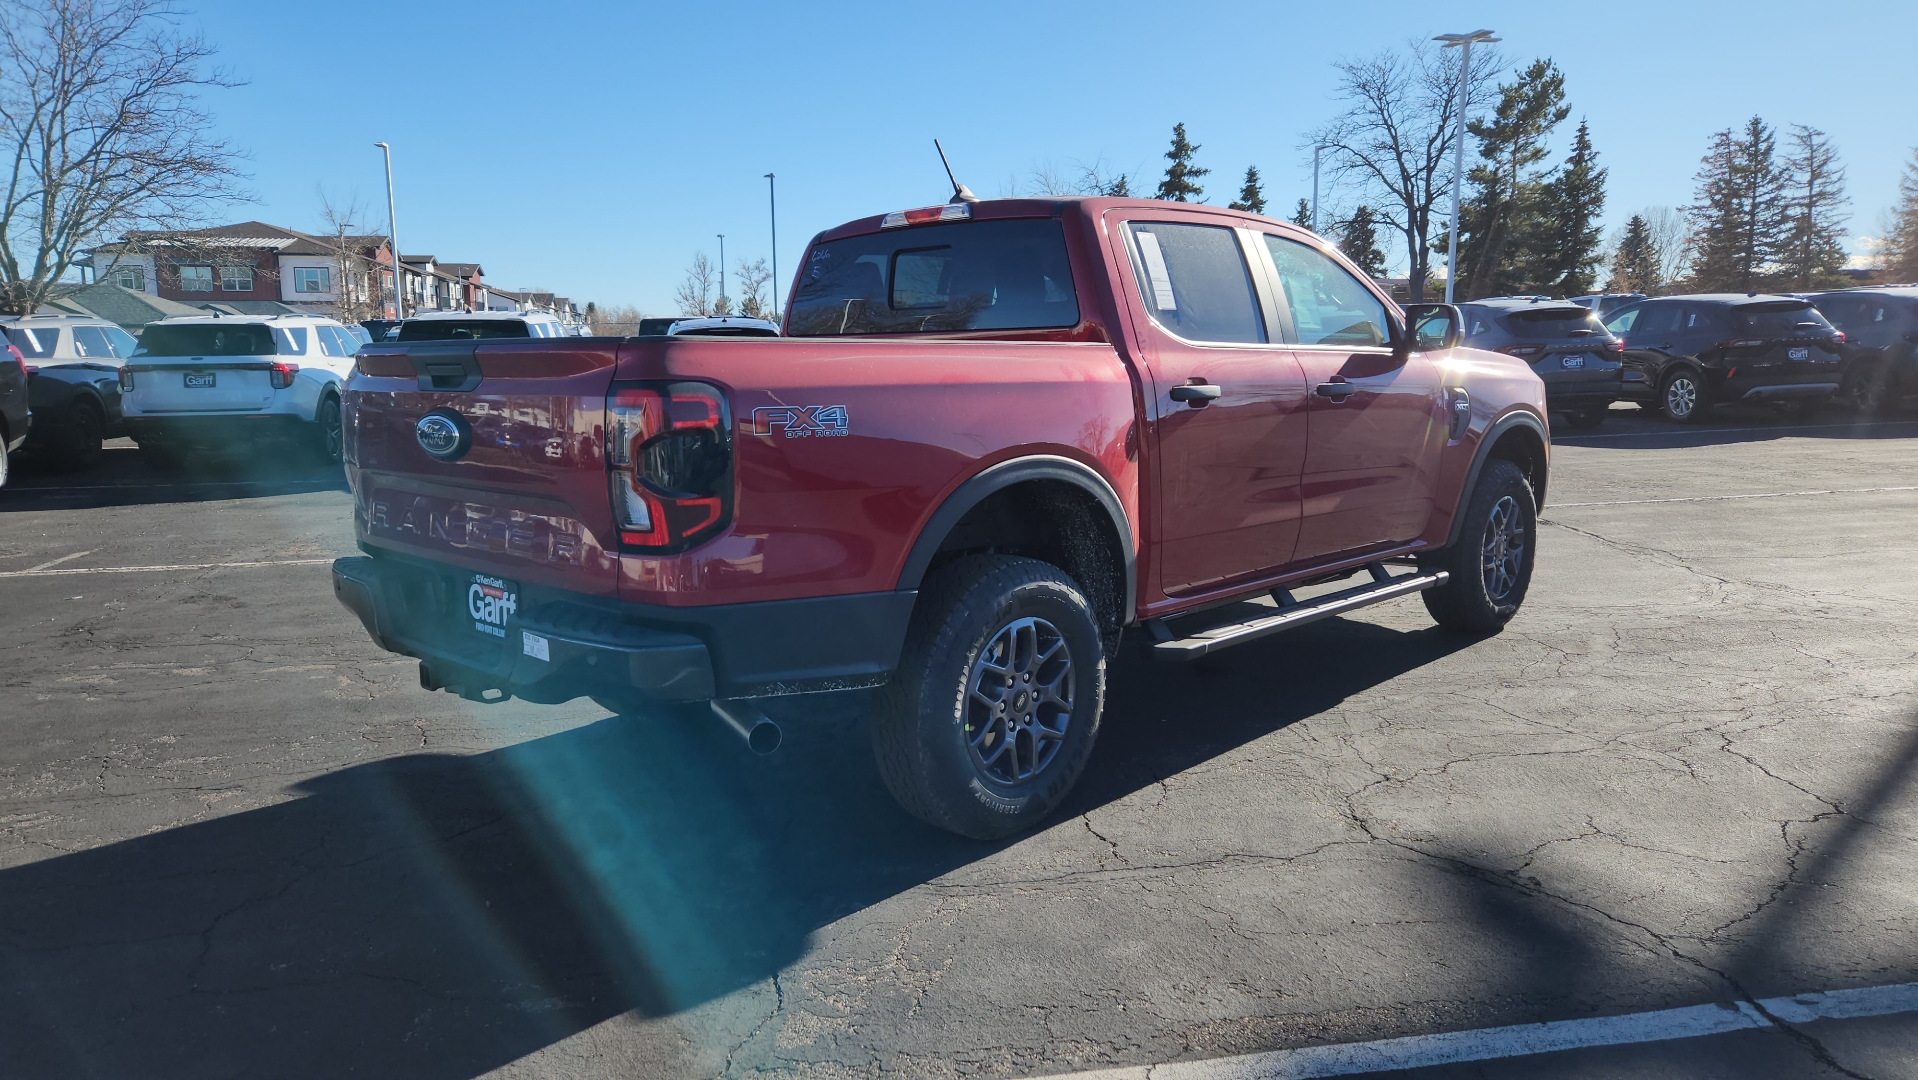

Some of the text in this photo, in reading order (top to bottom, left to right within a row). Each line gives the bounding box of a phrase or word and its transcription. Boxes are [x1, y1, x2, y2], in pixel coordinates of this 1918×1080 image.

[1562, 357, 1584, 367] Garff
[1786, 349, 1809, 359] Garff
[186, 375, 214, 386] Garff
[752, 405, 849, 435] FX4
[785, 429, 849, 438] OFF ROAD
[370, 499, 581, 566] RANGER
[468, 583, 517, 627] Garff
[974, 791, 1021, 814] TERRITORY
